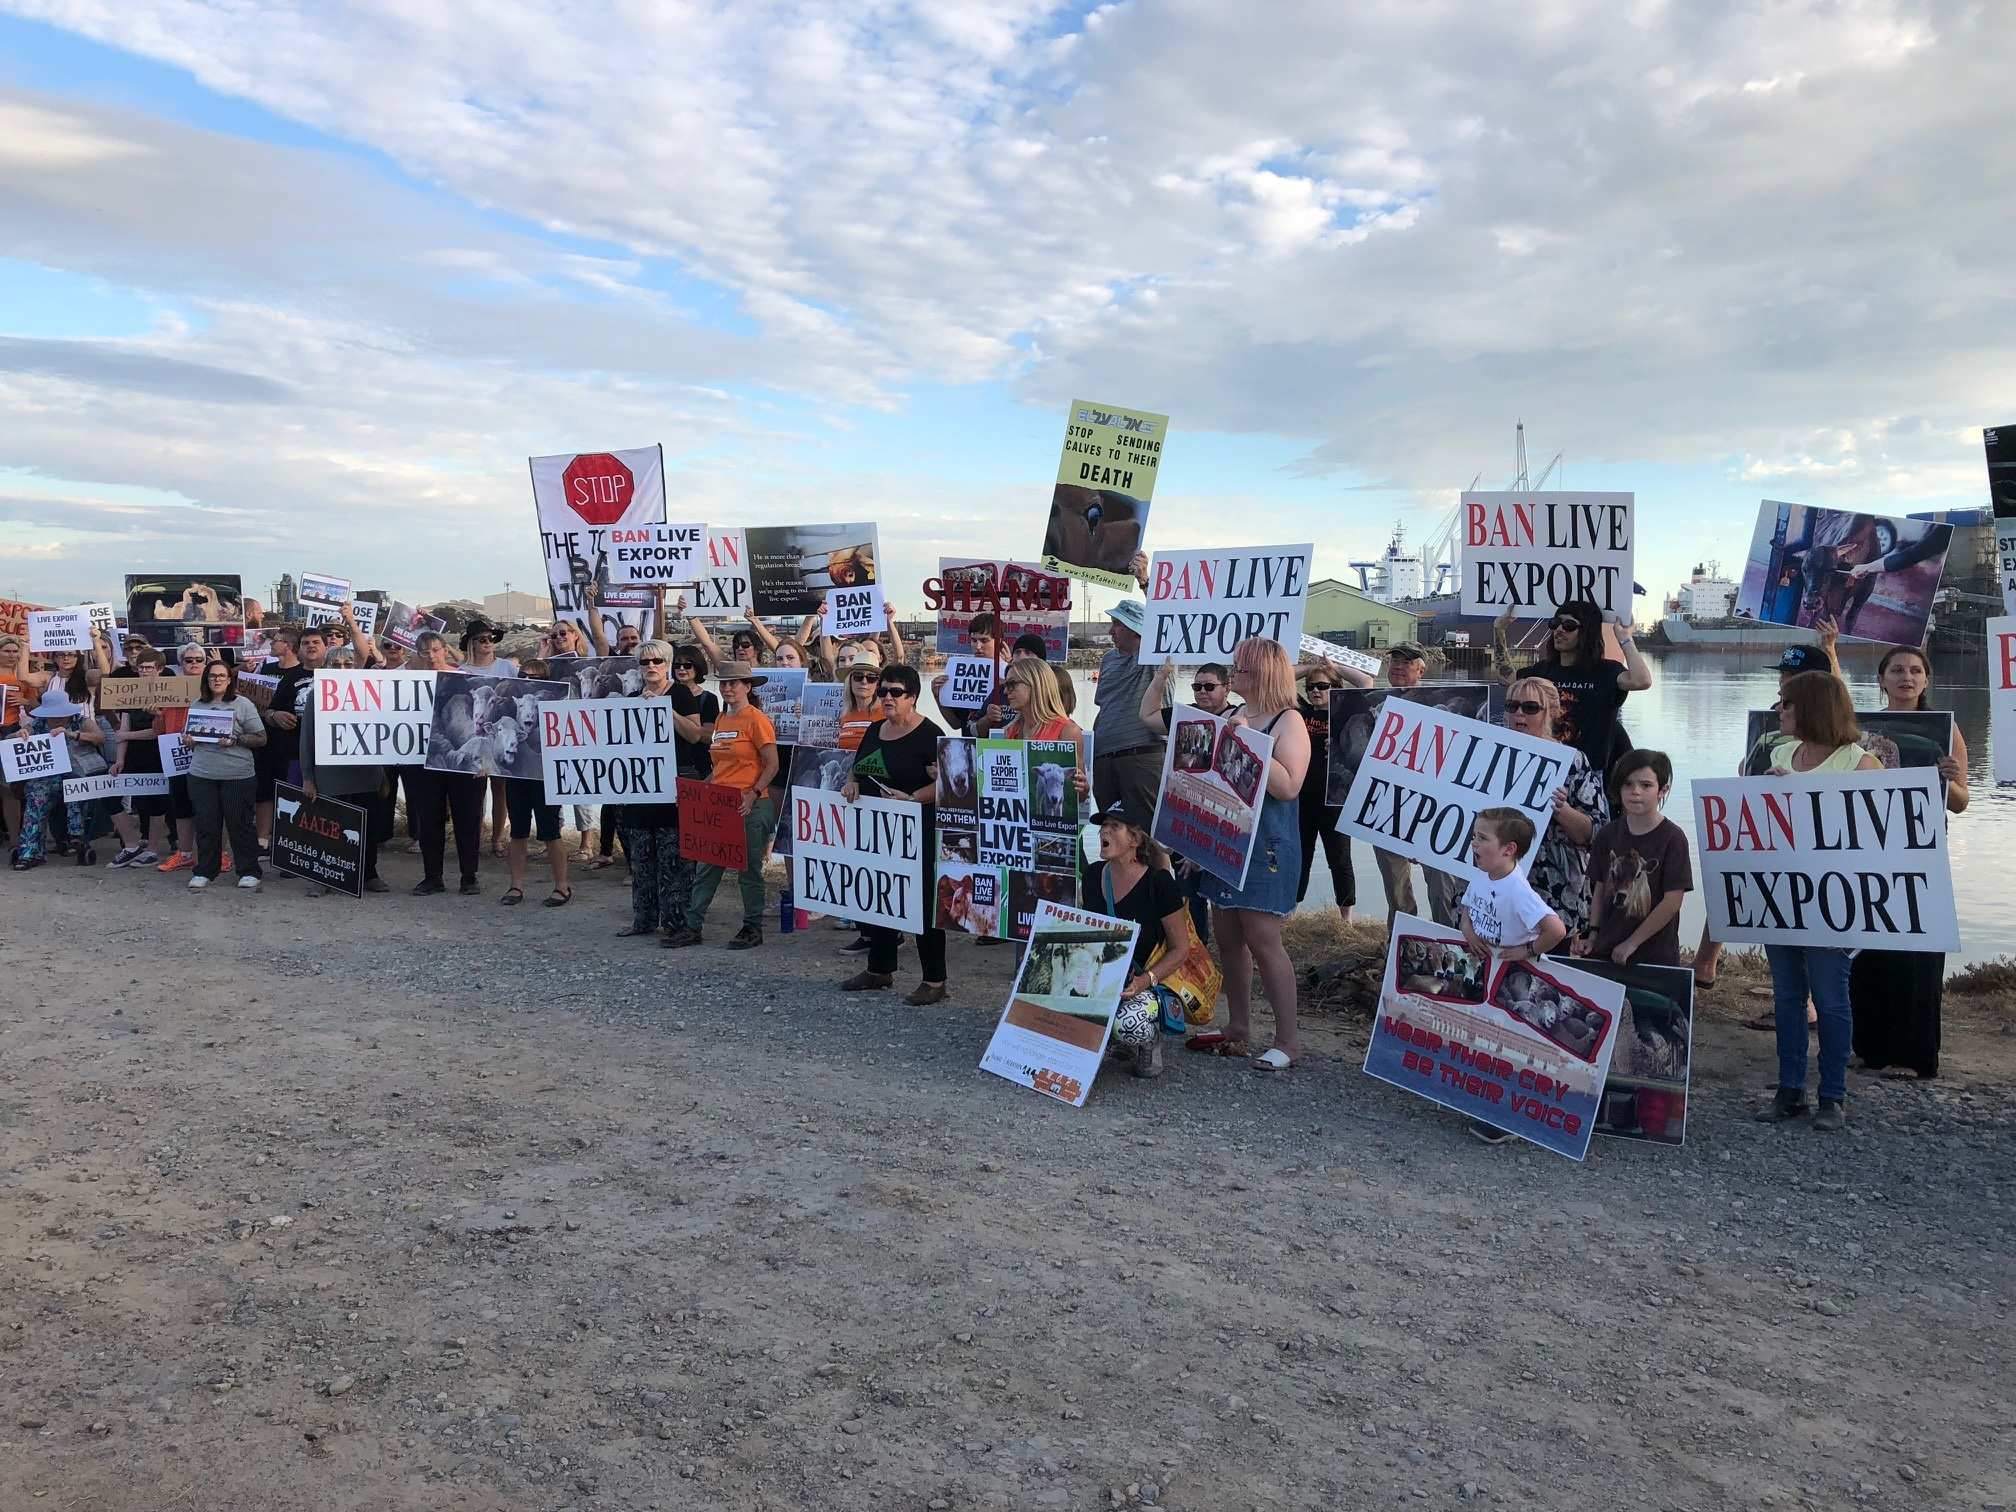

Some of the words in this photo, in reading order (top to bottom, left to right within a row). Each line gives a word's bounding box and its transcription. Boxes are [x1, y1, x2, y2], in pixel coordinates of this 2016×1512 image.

[1068, 425, 1094, 439] STOP
[1116, 435, 1161, 453] SENDING
[1065, 440, 1102, 457] CALVES
[1108, 449, 1121, 460] TO
[1128, 452, 1158, 468] THEIR
[1079, 462, 1133, 489] DEATH
[573, 474, 626, 506] STOP
[611, 529, 650, 543] BAN
[657, 528, 700, 542] LIVE
[1466, 503, 1536, 547] BAN
[1545, 503, 1629, 551] LIVE
[541, 531, 581, 559] THE
[618, 547, 692, 562] EXPORT
[708, 536, 743, 567] AN
[630, 565, 674, 579] NOW
[1152, 559, 1220, 601] BAN
[1224, 556, 1305, 599] LIVE
[695, 577, 746, 608] EXP
[923, 577, 1073, 612] SHAME
[1475, 561, 1620, 611] EXPORT
[835, 592, 872, 607] BAN
[37, 615, 51, 623] LIVE
[52, 614, 78, 622] EXPORT
[90, 607, 110, 617] OSE
[352, 606, 373, 618] OSE
[836, 606, 872, 622] LIVE
[44, 629, 76, 638] ANIMAL
[836, 619, 872, 630] EXPORT
[1152, 611, 1290, 654] EXPORT
[44, 638, 77, 647] CRUELTY
[955, 662, 991, 678] BAN
[103, 683, 139, 696] STOP
[319, 679, 383, 712] BAN
[391, 679, 435, 712] LIV
[953, 678, 988, 694] LIVE
[952, 692, 987, 702] EXPORT
[543, 709, 598, 748] BAN
[604, 706, 670, 746] LIVE
[13, 738, 51, 755] BAN
[1031, 741, 1055, 751] save
[1057, 743, 1075, 753] me
[16, 751, 54, 767] LIVE
[996, 755, 1012, 766] LIVE
[1370, 710, 1459, 779] BAN
[1451, 735, 1562, 813] LIVE
[18, 763, 55, 775] EXPORT
[553, 757, 665, 796] EXPORT
[991, 766, 1018, 778] EXPORT
[64, 781, 90, 796] BAN
[95, 778, 120, 791] LIVE
[124, 777, 168, 788] EXPORT
[693, 808, 723, 828] LIVE
[936, 812, 952, 823] FOR
[953, 814, 976, 825] THEM
[979, 797, 1028, 823] BAN
[1700, 792, 1796, 852] BAN
[1806, 786, 1936, 852] LIVE
[298, 811, 341, 840] AALE
[795, 798, 847, 849] BAN
[853, 806, 918, 861] LIVE
[1031, 819, 1045, 828] Ban
[1045, 820, 1057, 829] Live
[1057, 821, 1078, 832] Export
[980, 823, 1032, 854] LIVE
[277, 835, 318, 858] Adelaide
[320, 850, 356, 872] Against
[684, 833, 744, 864] EXPORTS
[289, 853, 310, 869] Live
[312, 861, 345, 882] Export
[980, 850, 1032, 869] EXPORT
[803, 856, 911, 920] EXPORT
[974, 887, 993, 896] LIVE
[975, 877, 993, 887] BAN
[1720, 870, 1929, 935] EXPORT
[1084, 916, 1111, 930] save
[1518, 1068, 1570, 1103] CRY
